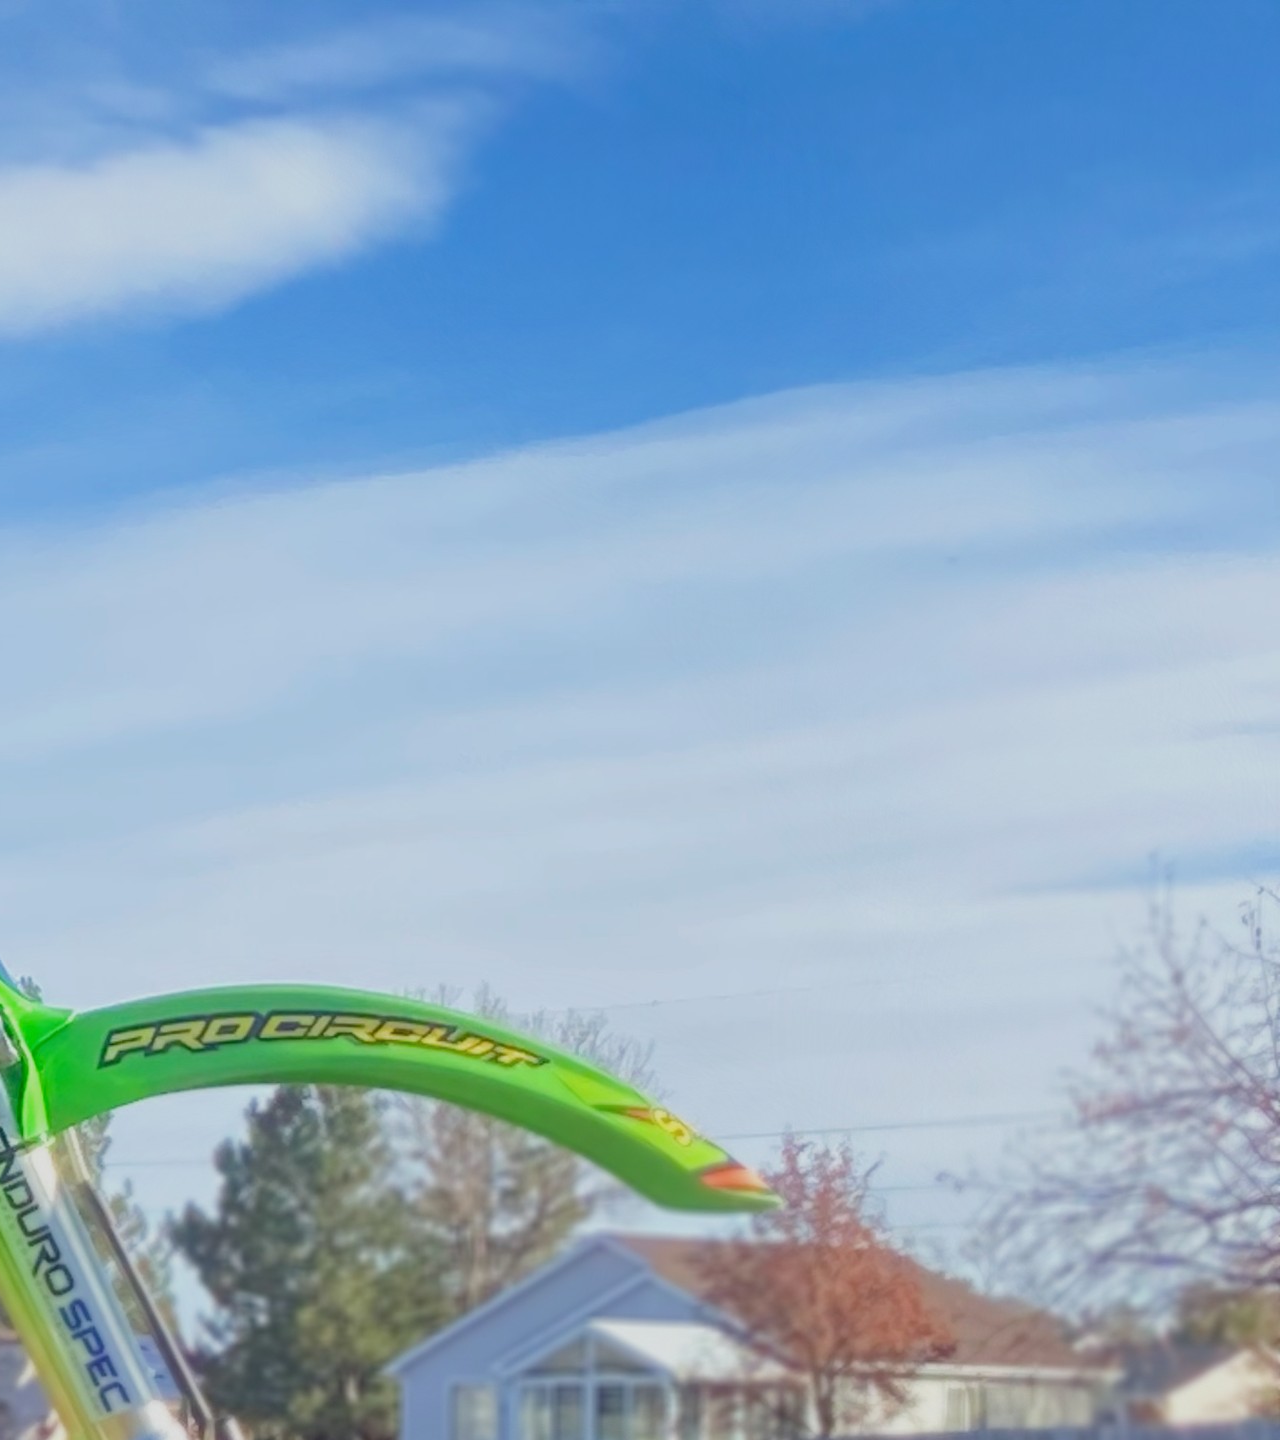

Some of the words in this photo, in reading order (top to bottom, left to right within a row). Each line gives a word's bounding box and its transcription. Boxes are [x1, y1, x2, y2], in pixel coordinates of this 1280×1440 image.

[100, 1012, 256, 1067] PRO
[256, 1010, 548, 1067] CIRCUIT
[59, 1299, 130, 1413] SPEC
